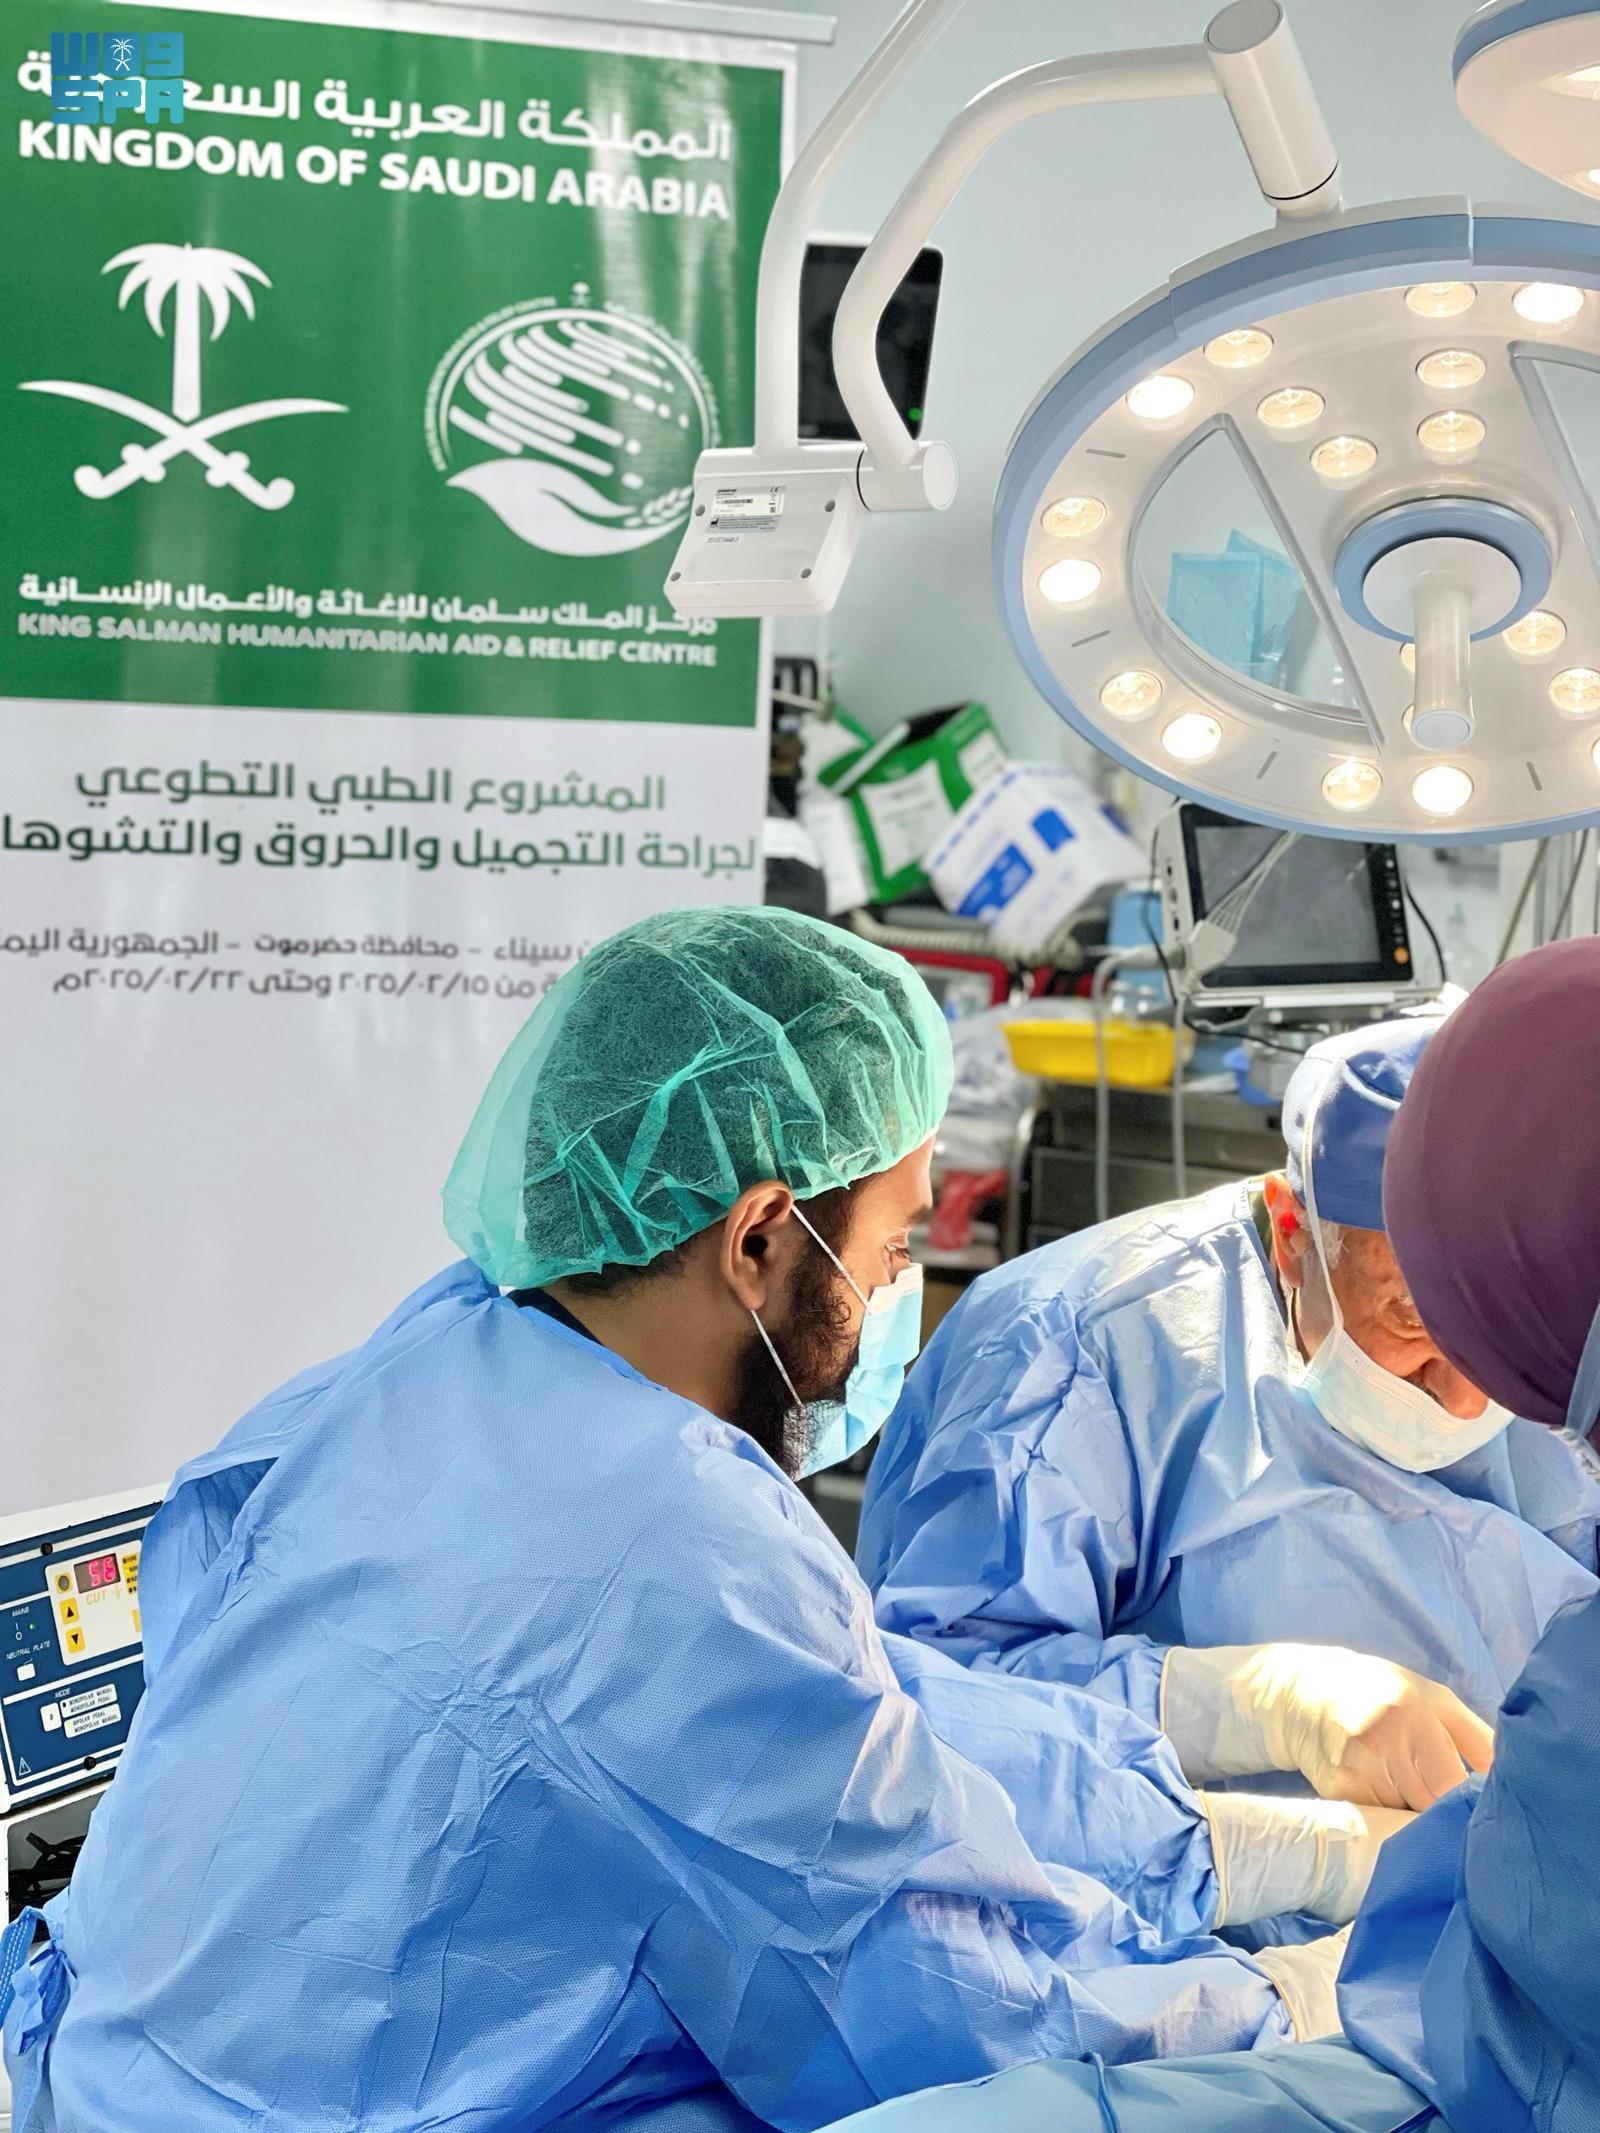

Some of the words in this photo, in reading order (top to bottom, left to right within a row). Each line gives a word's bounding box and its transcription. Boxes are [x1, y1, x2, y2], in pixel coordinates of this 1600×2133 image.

[313, 79, 505, 140] العربية
[517, 98, 732, 160] المملكة
[19, 119, 285, 180] KINGDOM
[295, 144, 368, 186] OF
[379, 152, 537, 203] SAUDI
[546, 168, 730, 220] ARABIA
[18, 573, 172, 612] الإنسانية
[431, 595, 550, 625] سلمان
[551, 601, 644, 630] الملك
[18, 612, 92, 638] KING
[97, 616, 222, 645] SALMAN
[227, 622, 449, 654] HUMANITARIAN
[452, 633, 502, 656] AID
[503, 635, 525, 657] &
[528, 636, 617, 662] RELIEF
[619, 641, 718, 667] CENTRE
[76, 759, 294, 809] التطوعي
[308, 765, 451, 816] الطبي
[463, 769, 665, 815] المشروع
[3, 813, 242, 866] والتشوها
[255, 822, 440, 871] والحروق
[453, 828, 624, 875] التجميل
[637, 831, 755, 880] لجراحة
[0, 927, 60, 958] اليم
[67, 928, 219, 960] الجمهورية
[254, 932, 357, 958] حضرموت
[360, 933, 459, 959] محافظة
[249, 968, 332, 998] وحتى
[494, 974, 537, 1000] من
[11, 1606, 30, 1618] MAINS
[6, 1647, 31, 1660] NEUTRAL
[33, 1640, 51, 1652] PLATE
[55, 1687, 71, 1699] MODE
